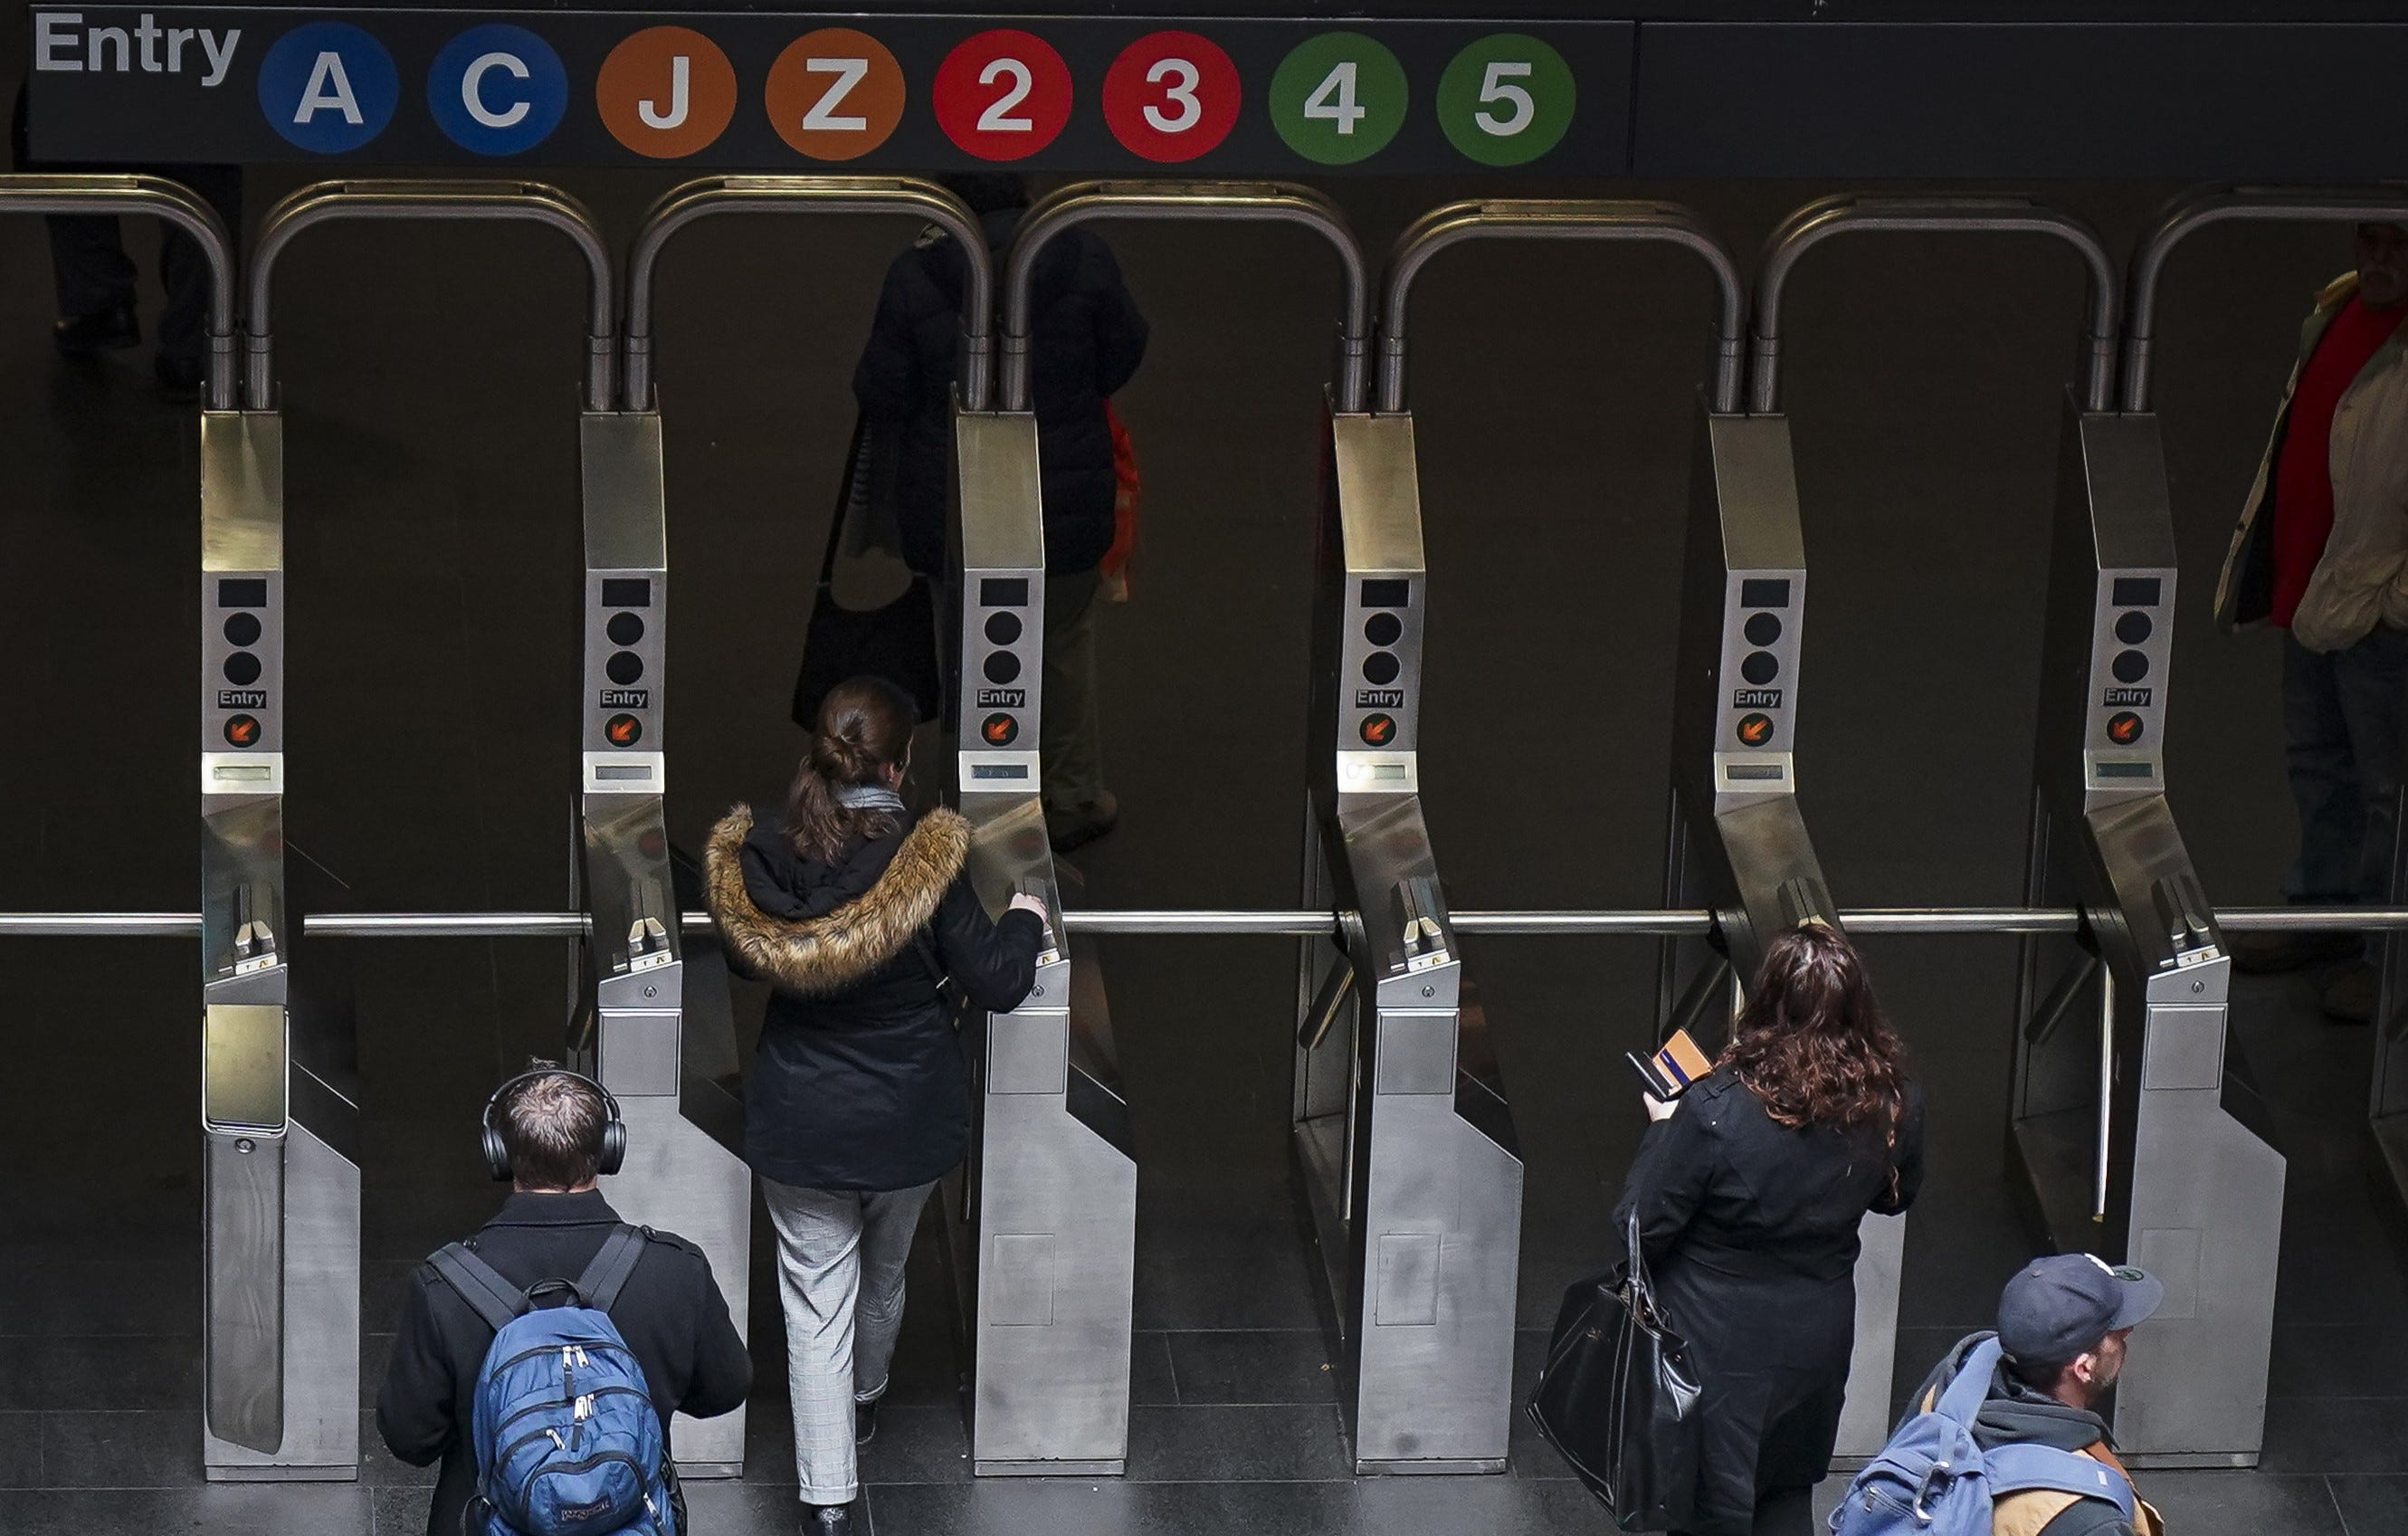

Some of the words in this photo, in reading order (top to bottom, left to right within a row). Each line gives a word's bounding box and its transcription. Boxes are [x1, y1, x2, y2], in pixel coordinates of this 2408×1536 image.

[35, 13, 242, 87] Entry
[293, 52, 364, 124] A
[462, 52, 530, 128] C
[638, 56, 690, 129] J
[802, 58, 869, 130] Z
[976, 58, 1033, 131] 2
[1143, 58, 1202, 133] 3
[1304, 62, 1366, 134] 4
[1475, 62, 1535, 137] 5
[220, 691, 264, 707] Entry
[602, 691, 646, 707] Entry
[978, 690, 1023, 706] Entry
[1357, 690, 1402, 706] Entry
[1735, 690, 1779, 706] Entry
[2105, 688, 2149, 705] Entry
